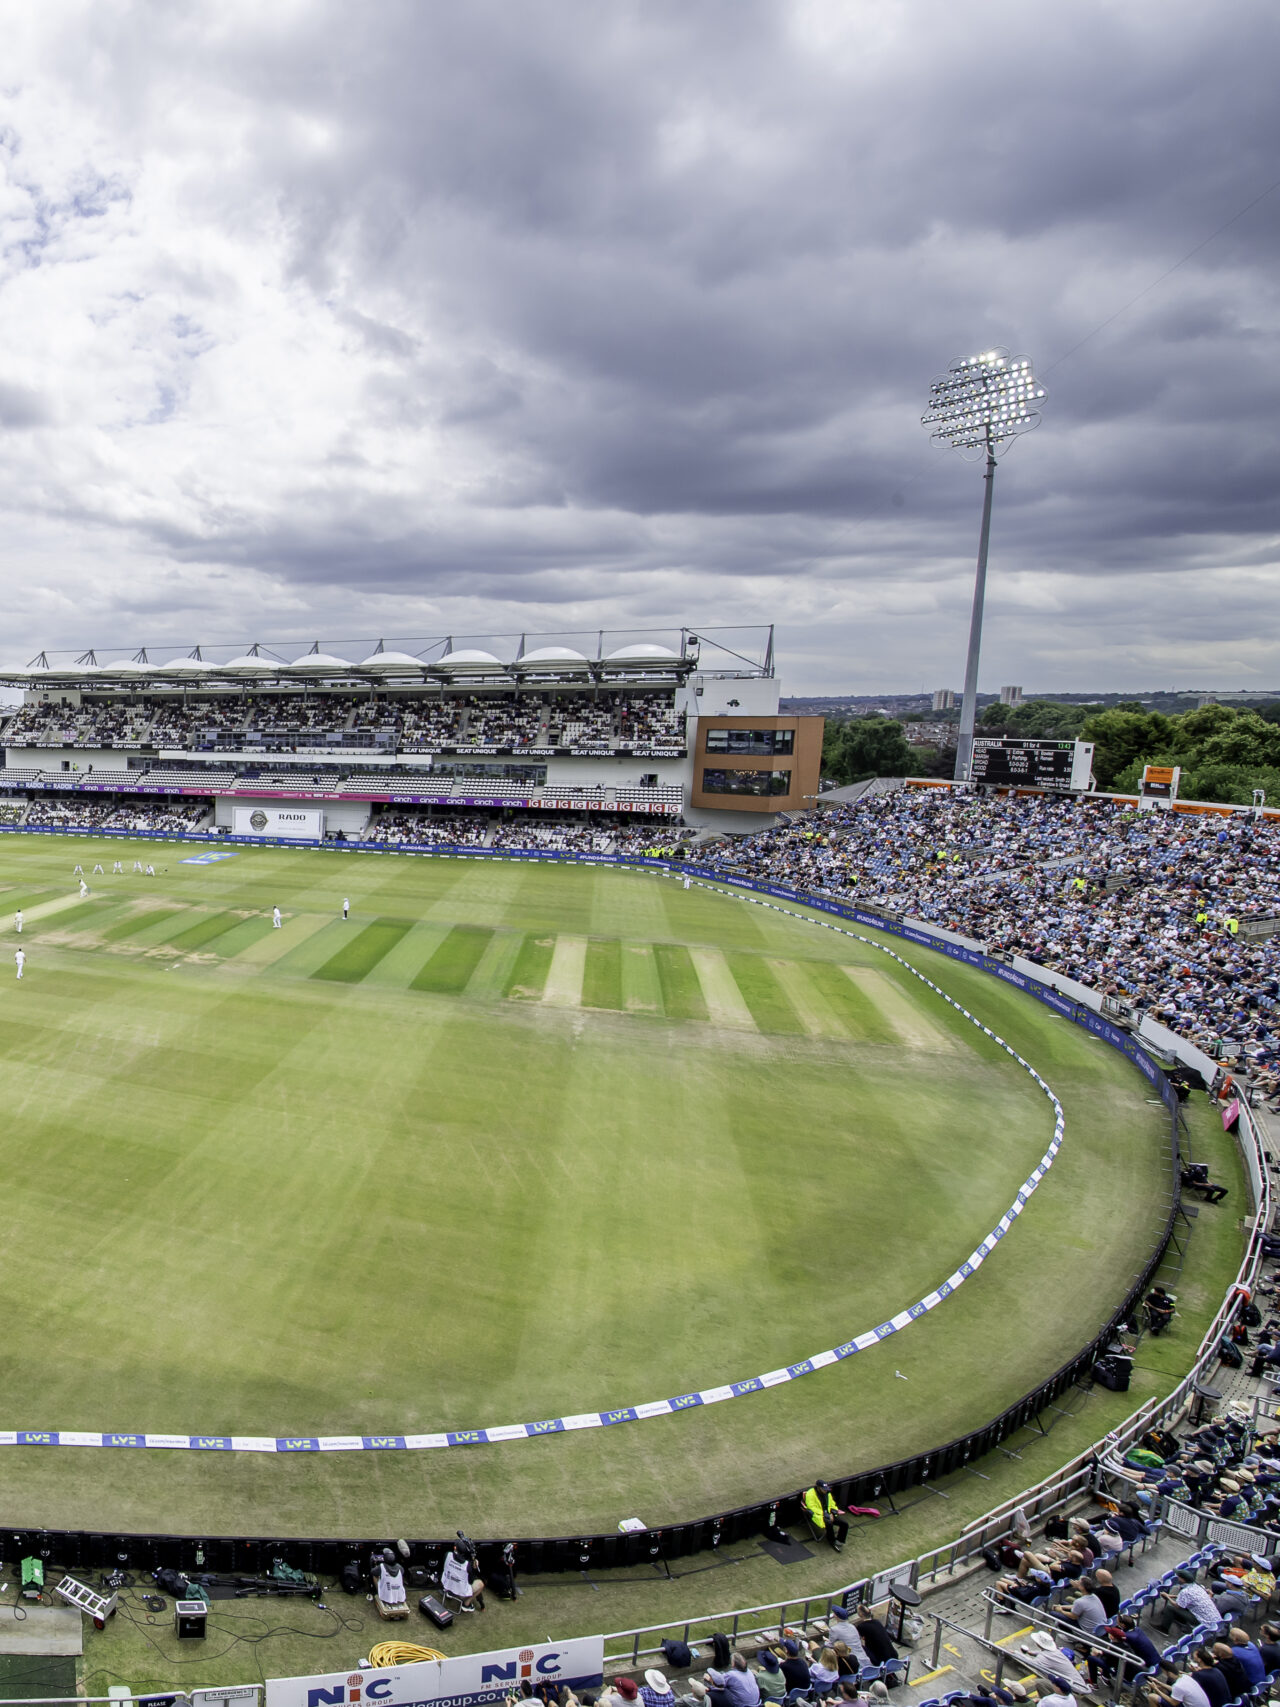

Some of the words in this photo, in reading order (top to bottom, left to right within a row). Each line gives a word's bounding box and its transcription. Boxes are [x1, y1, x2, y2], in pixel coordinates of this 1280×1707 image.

[652, 750, 678, 758] UNIQUE
[473, 798, 494, 806] cinch
[502, 799, 522, 807] cinch
[544, 800, 554, 808] IG
[574, 801, 584, 809] IG
[604, 802, 615, 810] IG
[635, 803, 646, 811] IG
[652, 804, 663, 812] IG
[667, 804, 678, 812] IG
[536, 1673, 562, 1682] GROUP
